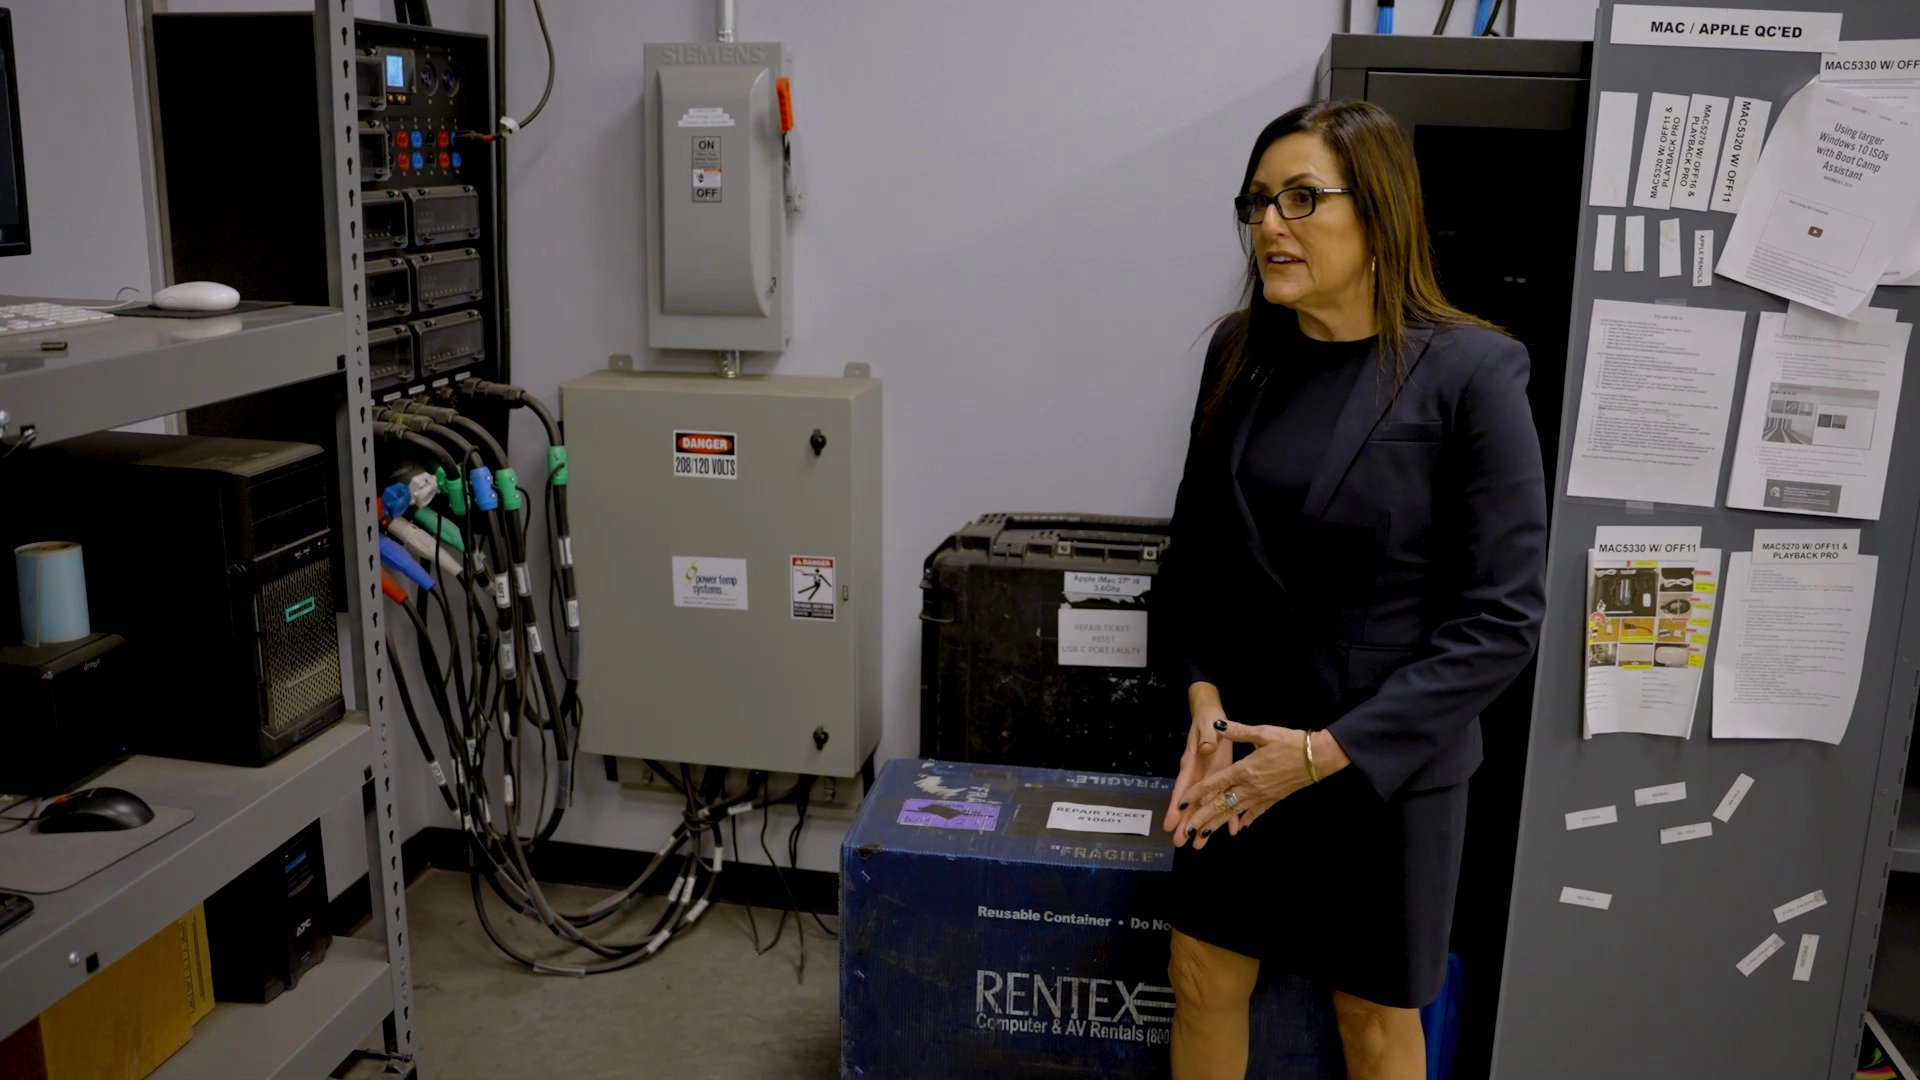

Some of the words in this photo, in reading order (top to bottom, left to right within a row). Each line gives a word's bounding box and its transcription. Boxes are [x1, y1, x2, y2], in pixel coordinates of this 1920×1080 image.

[1650, 21, 1685, 33] MAC
[1698, 23, 1750, 36] APPLE
[1754, 25, 1803, 38] QC'ED
[661, 46, 764, 65] SIEMENS
[1825, 60, 1877, 71] MAC5330
[1879, 60, 1895, 70] W/
[1660, 115, 1671, 143] OFF11
[1697, 104, 1713, 146] MAC5270
[1733, 100, 1752, 151] MAC5320
[1834, 122, 1858, 140] Using
[1858, 130, 1885, 146] larger
[698, 140, 715, 150] ON
[1684, 116, 1700, 165] PLAYBACK
[1819, 131, 1856, 151] Windows
[1858, 144, 1869, 155] 10
[1868, 147, 1890, 161] ISOs
[1657, 145, 1666, 157] W/
[1661, 139, 1677, 188] PLAYBACK
[1670, 116, 1681, 137] PRO
[1696, 147, 1704, 160] W/
[1729, 153, 1740, 168] W/
[1816, 146, 1835, 158] with
[1835, 150, 1856, 165] Boot
[1856, 157, 1881, 174] Camp
[1650, 159, 1663, 199] MAC5320
[1680, 167, 1690, 187] PRO
[1689, 160, 1701, 189] OFF16
[1822, 160, 1863, 181] Assistant
[696, 188, 719, 198] OFF
[1722, 169, 1737, 203] OFF11
[682, 437, 728, 451] DANGER
[675, 456, 710, 474] 208/120
[712, 458, 736, 476] VOLTS
[1598, 544, 1646, 553] MAC5330
[1648, 544, 1663, 553] W/
[1664, 543, 1697, 553] OFF11
[695, 575, 717, 585] power
[1073, 575, 1096, 583] Apple
[1074, 624, 1102, 632] REPAIR
[1104, 624, 1130, 633] TICKET
[1088, 646, 1111, 654] PORT
[1112, 647, 1141, 655] FAULTY
[1056, 806, 1101, 816] REPAIR
[1104, 811, 1147, 819] TICKET
[296, 917, 312, 937] APC
[977, 905, 1041, 921] Reusable
[1043, 911, 1111, 927] Container
[1130, 917, 1149, 930] Do
[976, 969, 1145, 1025] RENTEX
[976, 1012, 1048, 1034] Computer
[1051, 1020, 1062, 1035] &
[1065, 1020, 1087, 1036] AV
[1090, 1021, 1145, 1042] Rentals
[1146, 1027, 1170, 1047] (800
